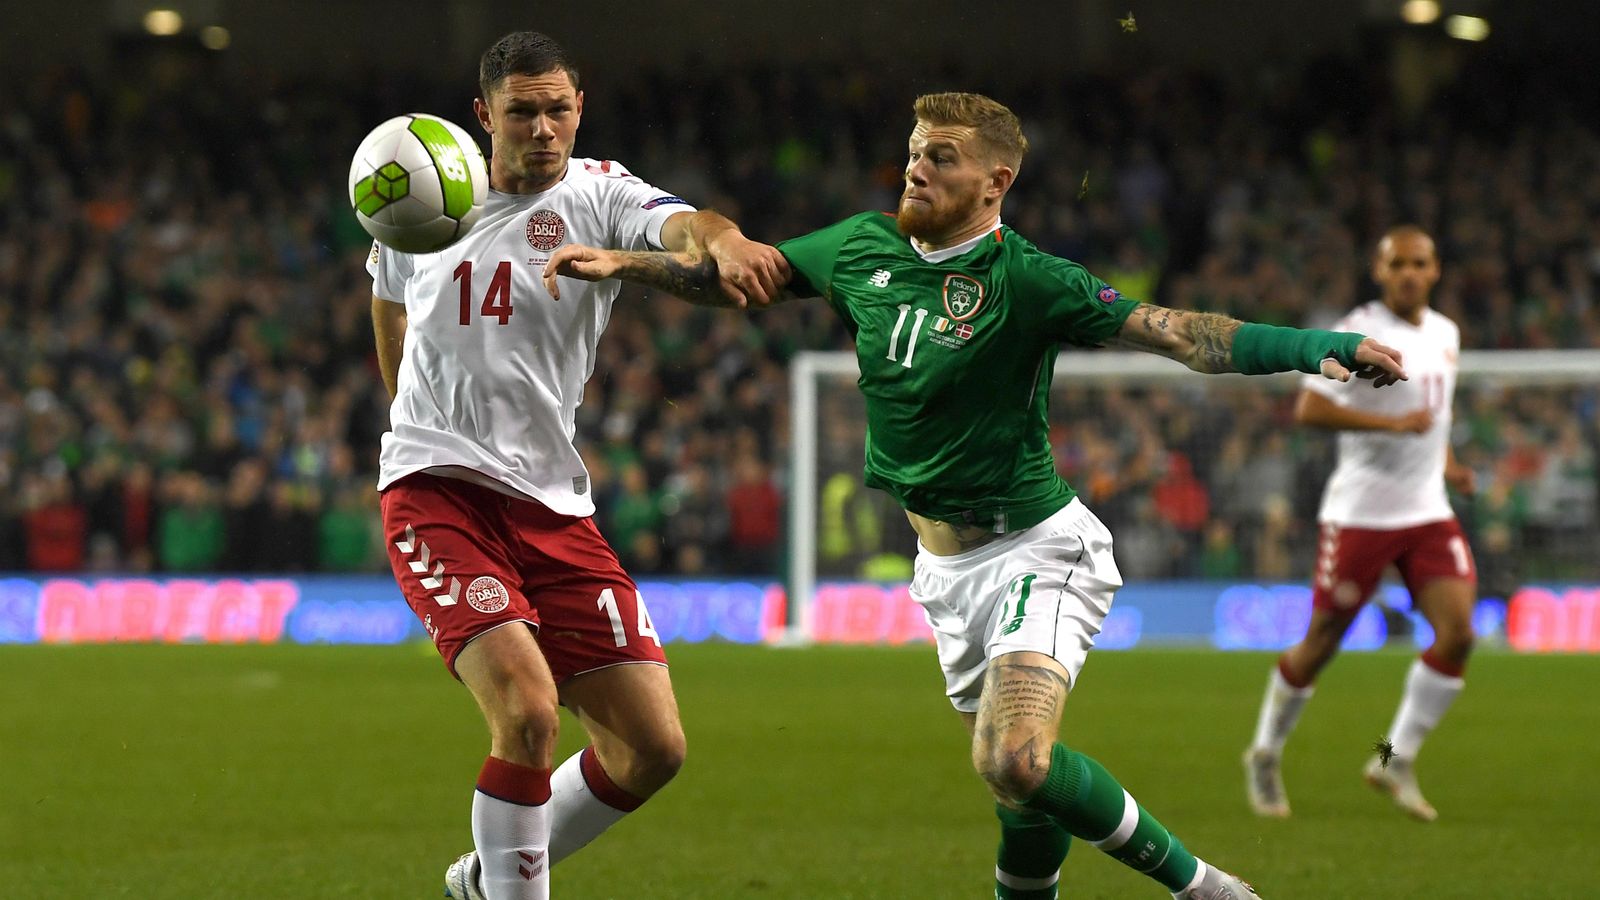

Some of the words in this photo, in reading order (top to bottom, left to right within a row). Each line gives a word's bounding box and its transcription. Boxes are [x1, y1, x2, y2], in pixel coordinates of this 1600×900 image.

[533, 223, 557, 237] DBU
[453, 260, 513, 326] 14
[952, 279, 977, 293] Ireland
[886, 303, 928, 368] 11
[476, 587, 500, 602] DBU
[597, 587, 661, 648] 14
